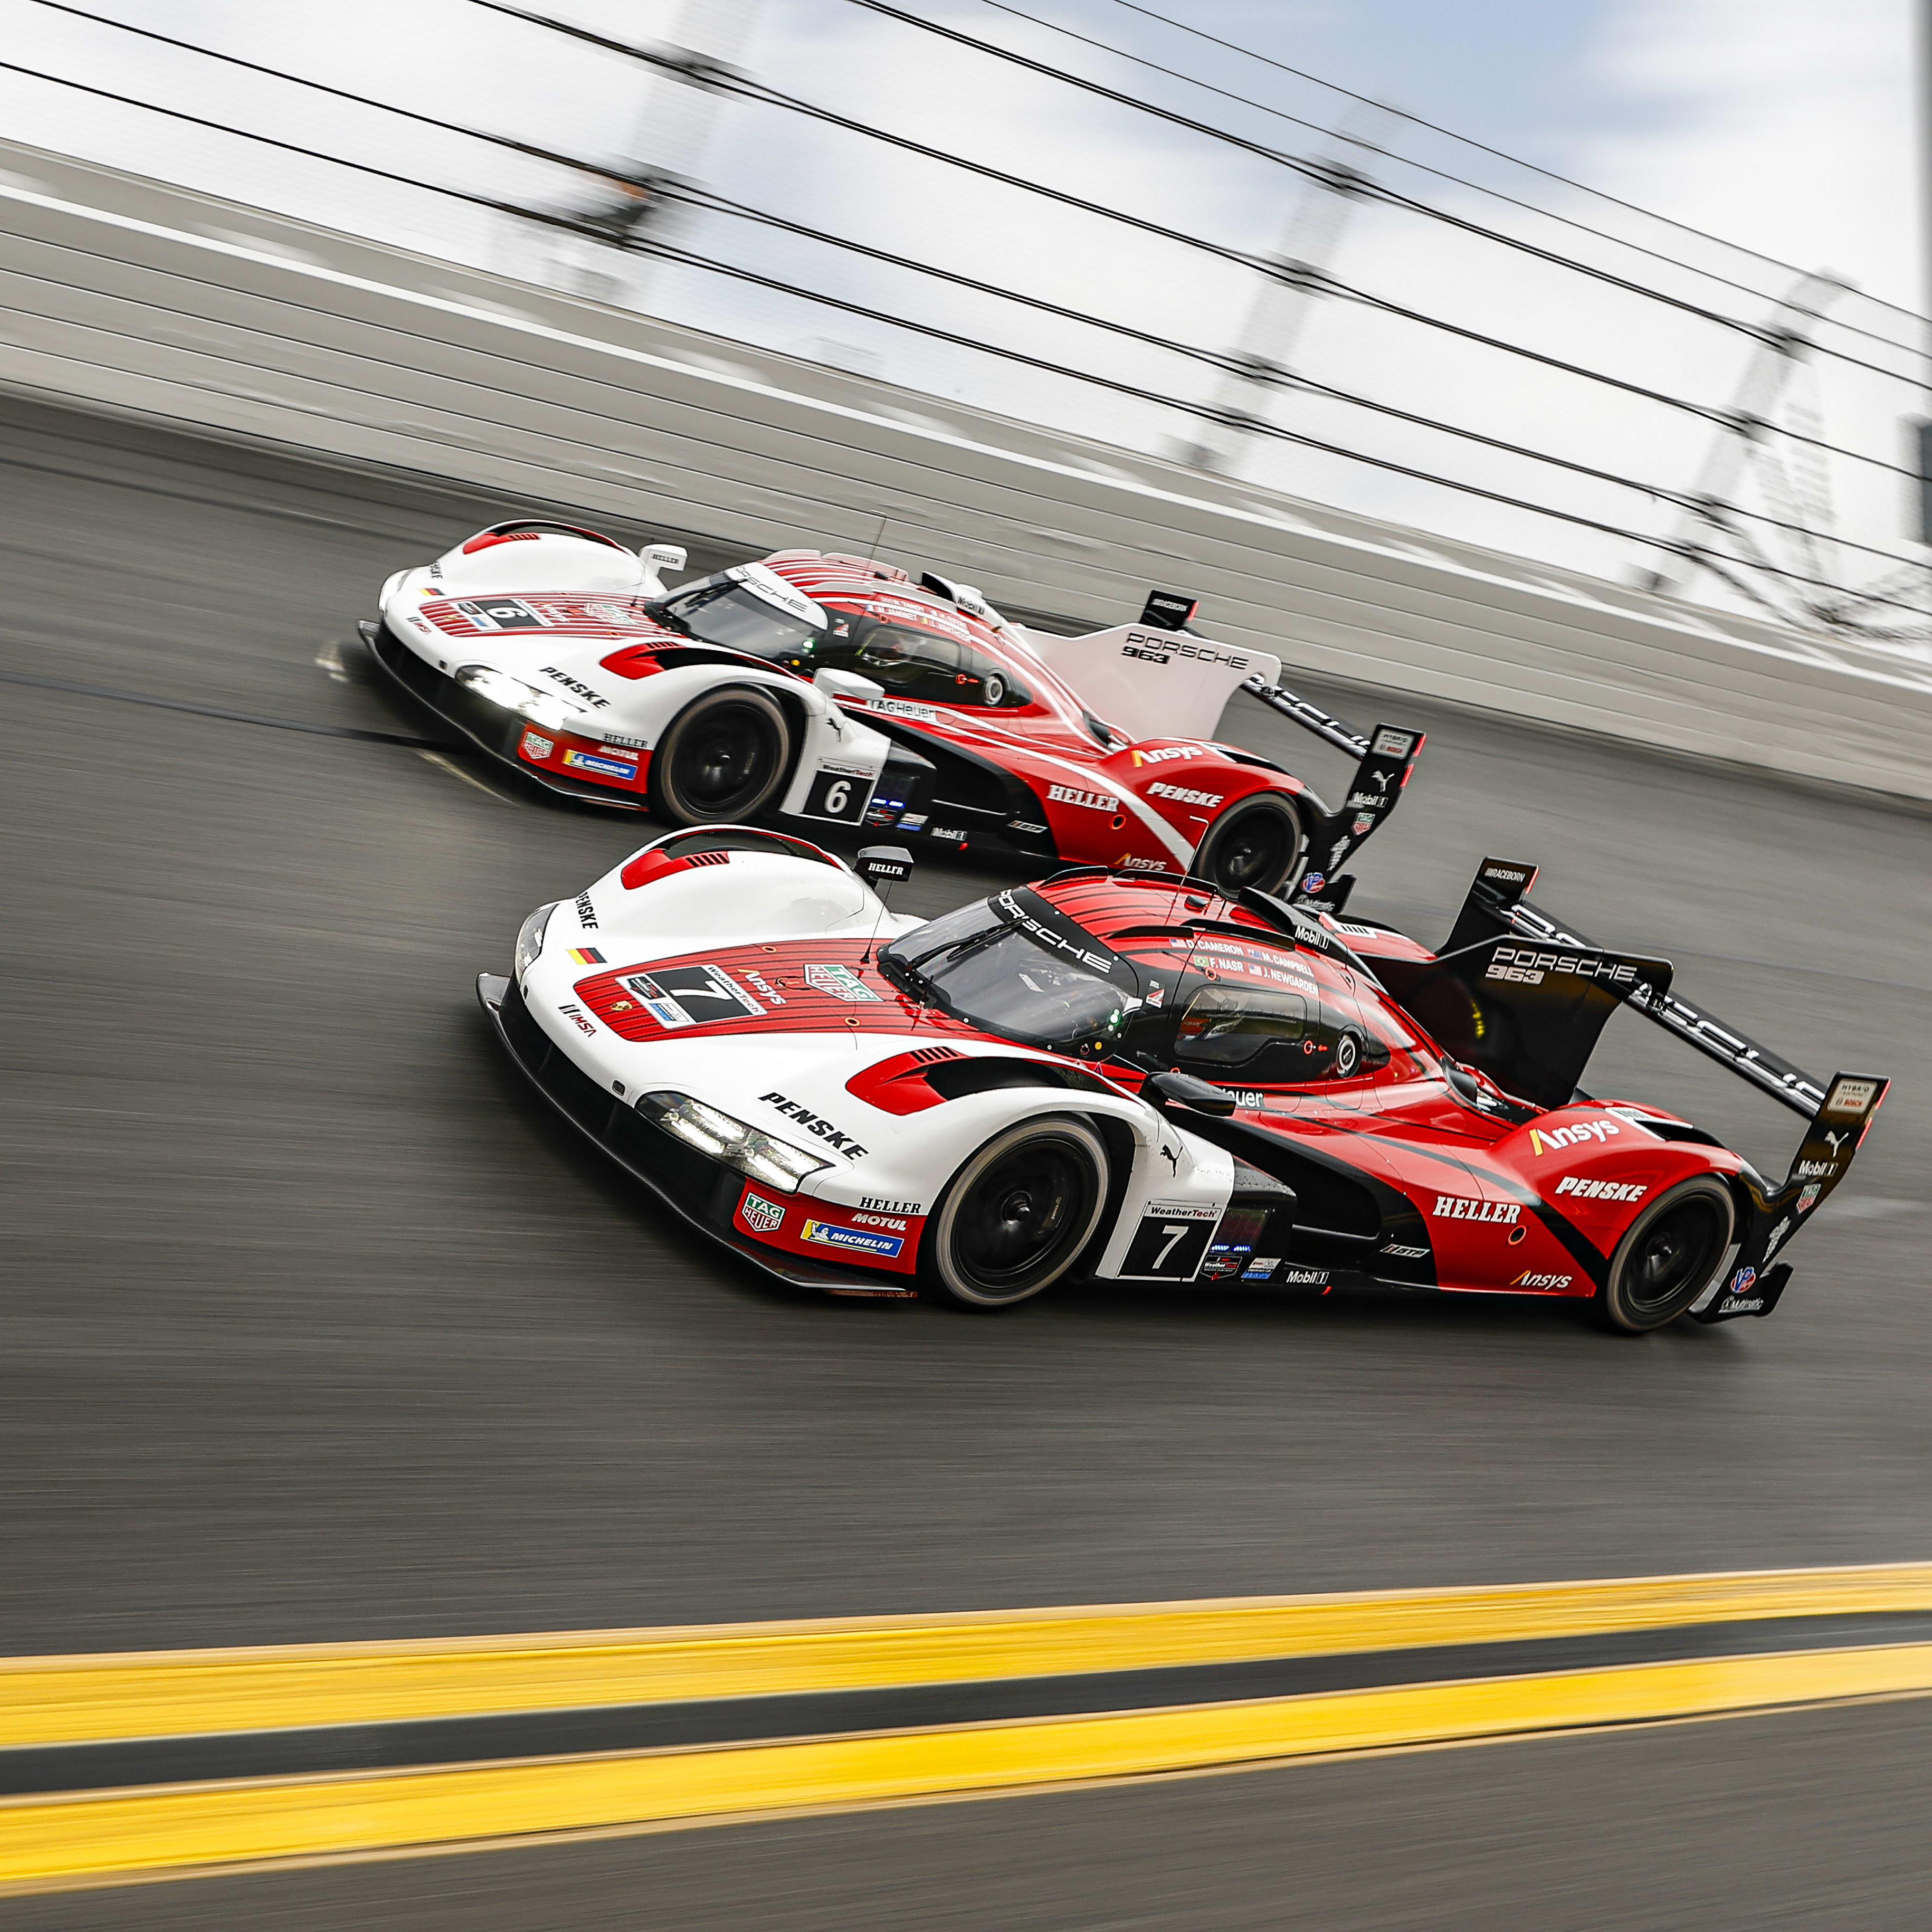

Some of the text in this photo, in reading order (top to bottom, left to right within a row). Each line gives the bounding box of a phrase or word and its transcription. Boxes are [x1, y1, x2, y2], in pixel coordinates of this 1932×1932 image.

[486, 607, 528, 618] 6
[1121, 646, 1170, 664] 963
[1125, 633, 1249, 670] PORSCHE
[538, 667, 611, 708] PENSKE
[603, 733, 648, 748] HELLER
[1131, 745, 1203, 767] Ansys
[824, 781, 851, 813] 6
[1046, 785, 1120, 812] HELLER
[1146, 782, 1224, 807] PENSKE
[1351, 792, 1379, 805] Mobil
[1115, 853, 1167, 871] Ansys
[1493, 868, 1525, 882] RACEBORN
[998, 889, 1112, 974] PORSCHE
[1295, 925, 1320, 945] Mobil
[1197, 940, 1243, 956] CAMERON
[1219, 959, 1244, 972] NASR
[1273, 955, 1314, 977] CAMPBELL
[1486, 965, 1544, 984] 963
[1492, 947, 1637, 982] PORSCHE
[669, 980, 733, 1000] 7
[708, 967, 759, 1014] WeatherTech
[737, 969, 787, 1005] Ansys
[810, 967, 854, 999] HEUER
[830, 967, 871, 999] TAG
[1271, 970, 1319, 995] NEWGARDEN
[569, 1014, 597, 1038] IMSA
[757, 1092, 869, 1160] PENSKE
[1529, 1118, 1620, 1157] Ansys
[1798, 1160, 1828, 1175] Mobil
[1555, 1176, 1647, 1202] PENSKE
[750, 1196, 781, 1219] TAG
[859, 1197, 921, 1214] HELLER
[1151, 1207, 1216, 1217] WeatherTech
[1433, 1196, 1520, 1223] HELLER
[744, 1207, 778, 1230] HEUER
[852, 1213, 907, 1231] MOTUL
[831, 1232, 893, 1250] MICHELIN
[1151, 1225, 1189, 1269] 7
[1286, 1271, 1316, 1283] Mobil
[1509, 1270, 1572, 1290] Ansys
